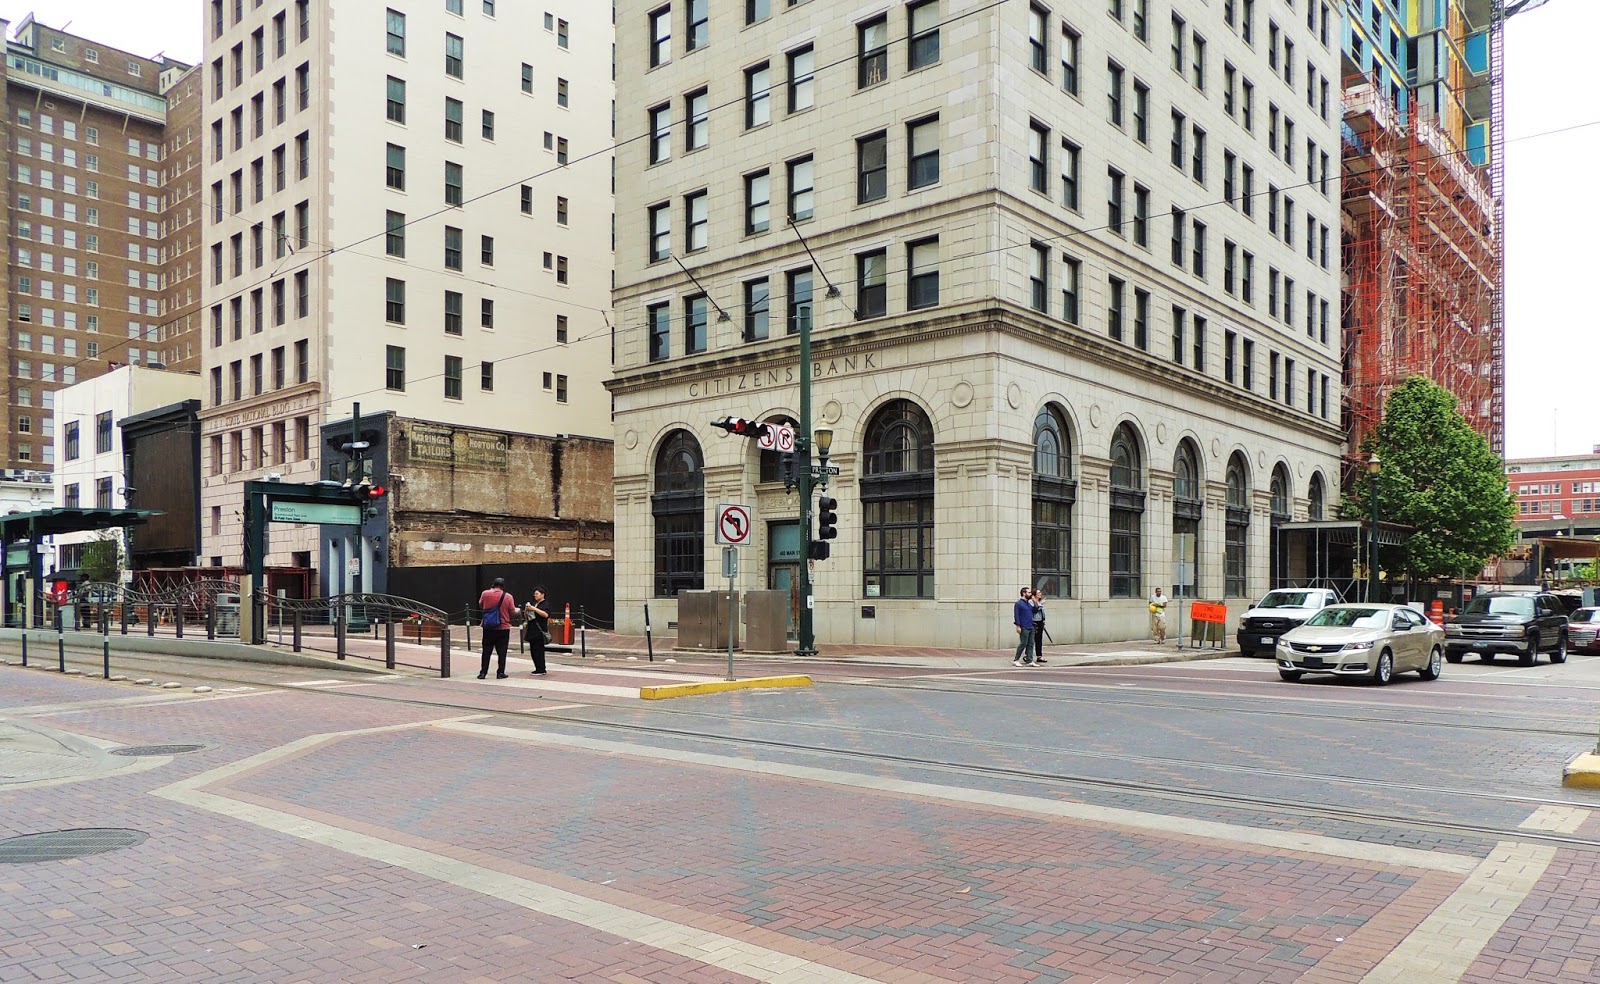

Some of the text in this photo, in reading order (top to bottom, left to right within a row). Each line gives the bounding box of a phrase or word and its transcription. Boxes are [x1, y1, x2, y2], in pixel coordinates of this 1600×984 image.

[689, 353, 876, 397] CITIZENS BANK
[242, 408, 270, 423] NATIONAL
[272, 403, 290, 416] BLDG
[415, 444, 451, 457] TAILORS
[274, 505, 296, 513] Preston
